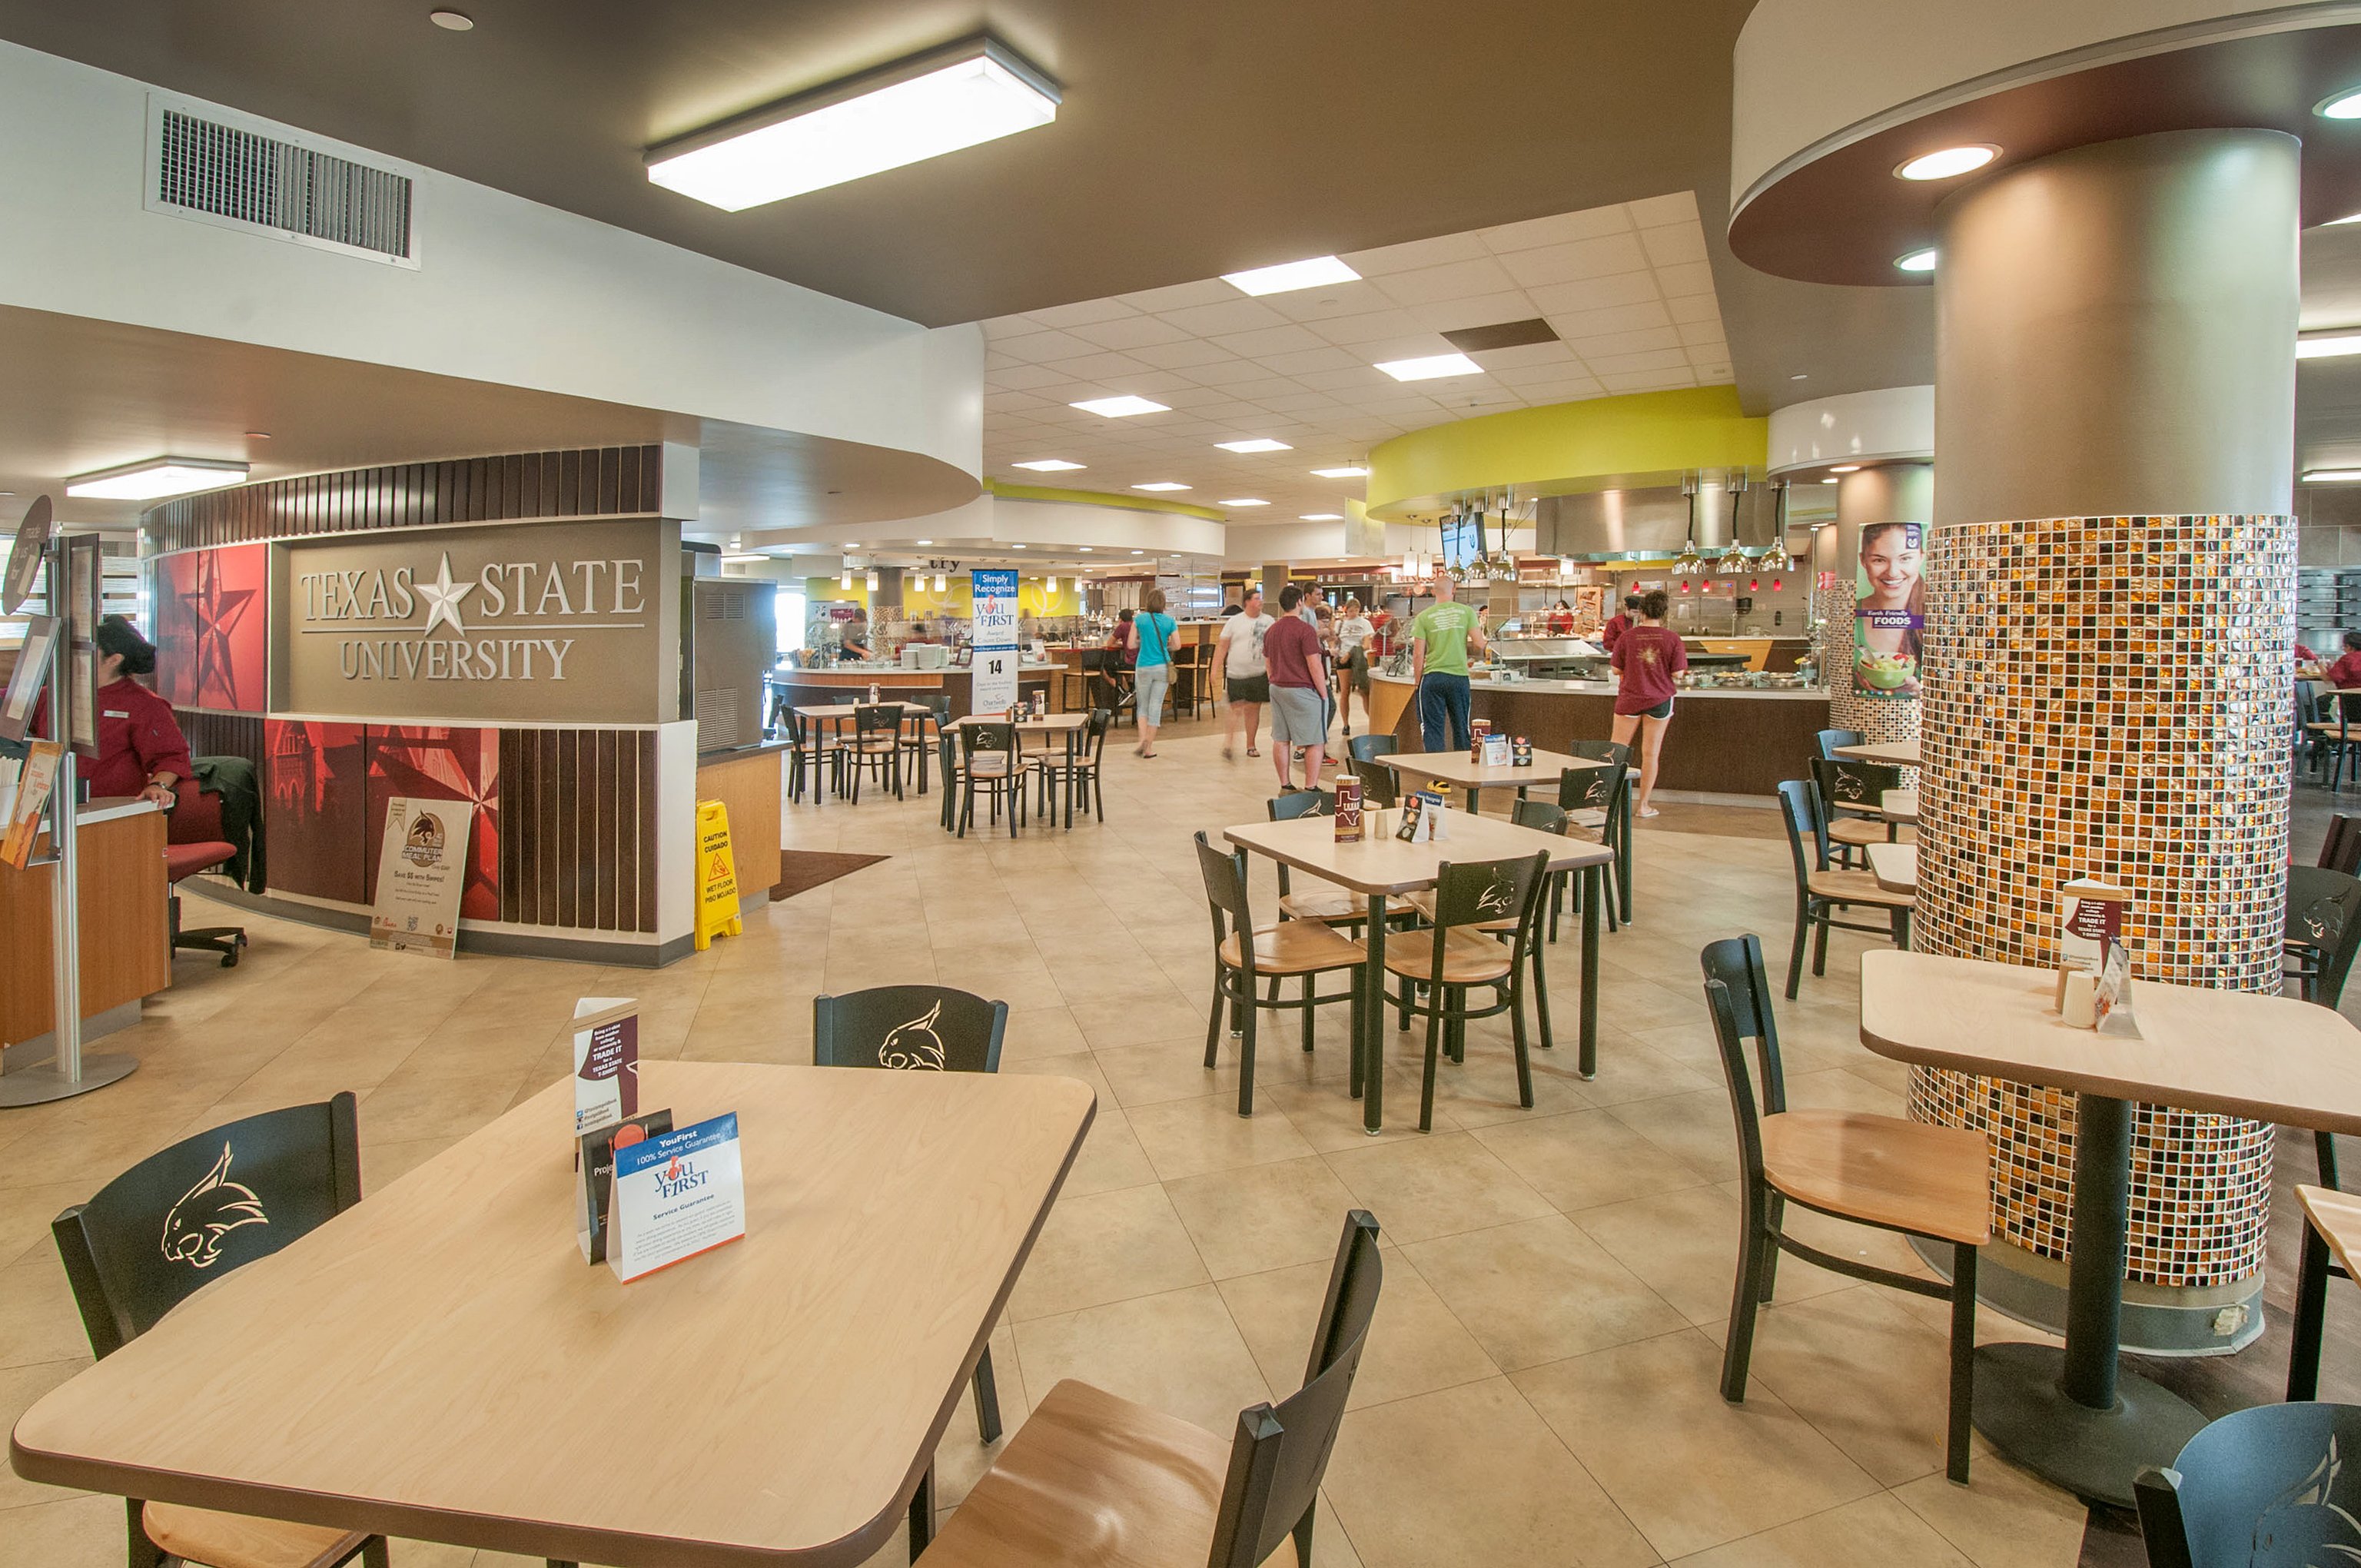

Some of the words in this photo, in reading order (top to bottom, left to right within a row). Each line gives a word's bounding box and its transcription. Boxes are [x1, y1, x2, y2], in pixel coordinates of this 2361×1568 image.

[982, 574, 1008, 584] Simply
[301, 567, 414, 620] TEXAS
[481, 560, 645, 617] STATE
[975, 584, 1015, 594] Recognize
[975, 603, 1005, 619] you
[1875, 616, 1911, 625] FOODS
[338, 639, 575, 680] UNIVERSITY
[988, 659, 1002, 674] 14
[703, 831, 727, 842] CAUTION
[404, 845, 443, 855] COMMUTER
[705, 841, 728, 852] CUIDADO
[706, 884, 716, 892] WET
[718, 879, 733, 889] FLOOR
[716, 887, 736, 899] MOJADO
[593, 1048, 615, 1061] TRADE
[616, 1045, 623, 1054] IT
[659, 1131, 698, 1148] YouFirst
[636, 1153, 656, 1166] 100%
[657, 1145, 683, 1158] Service
[685, 1132, 722, 1149] Guarantee
[594, 1164, 613, 1176] Proje
[655, 1161, 694, 1192] you
[653, 1207, 678, 1221] Service
[679, 1194, 715, 1211] Guarantee
